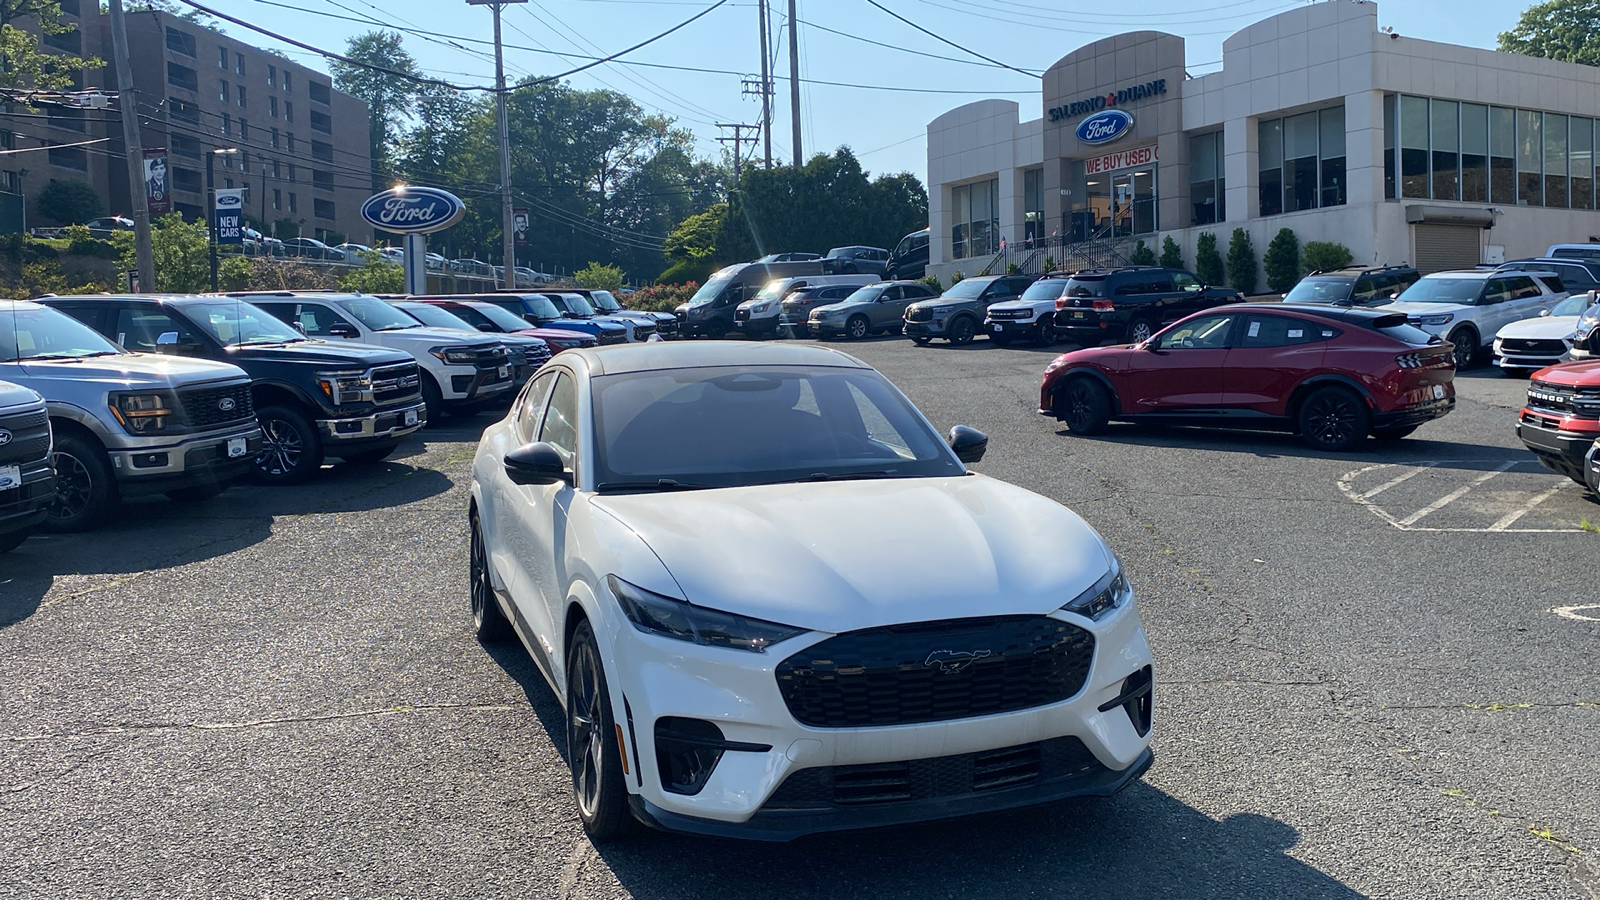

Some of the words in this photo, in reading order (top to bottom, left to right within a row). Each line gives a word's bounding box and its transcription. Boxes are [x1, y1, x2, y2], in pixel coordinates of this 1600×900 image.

[1048, 96, 1107, 121] SALERNO
[1117, 79, 1167, 104] DUANE
[1086, 118, 1117, 139] Ford
[1086, 159, 1101, 173] WE
[1103, 154, 1122, 171] BUY
[1125, 148, 1151, 166] USED
[380, 197, 436, 222] Ford
[220, 216, 238, 228] NEW
[220, 228, 239, 238] CARS
[1528, 390, 1564, 403] BRONCO
